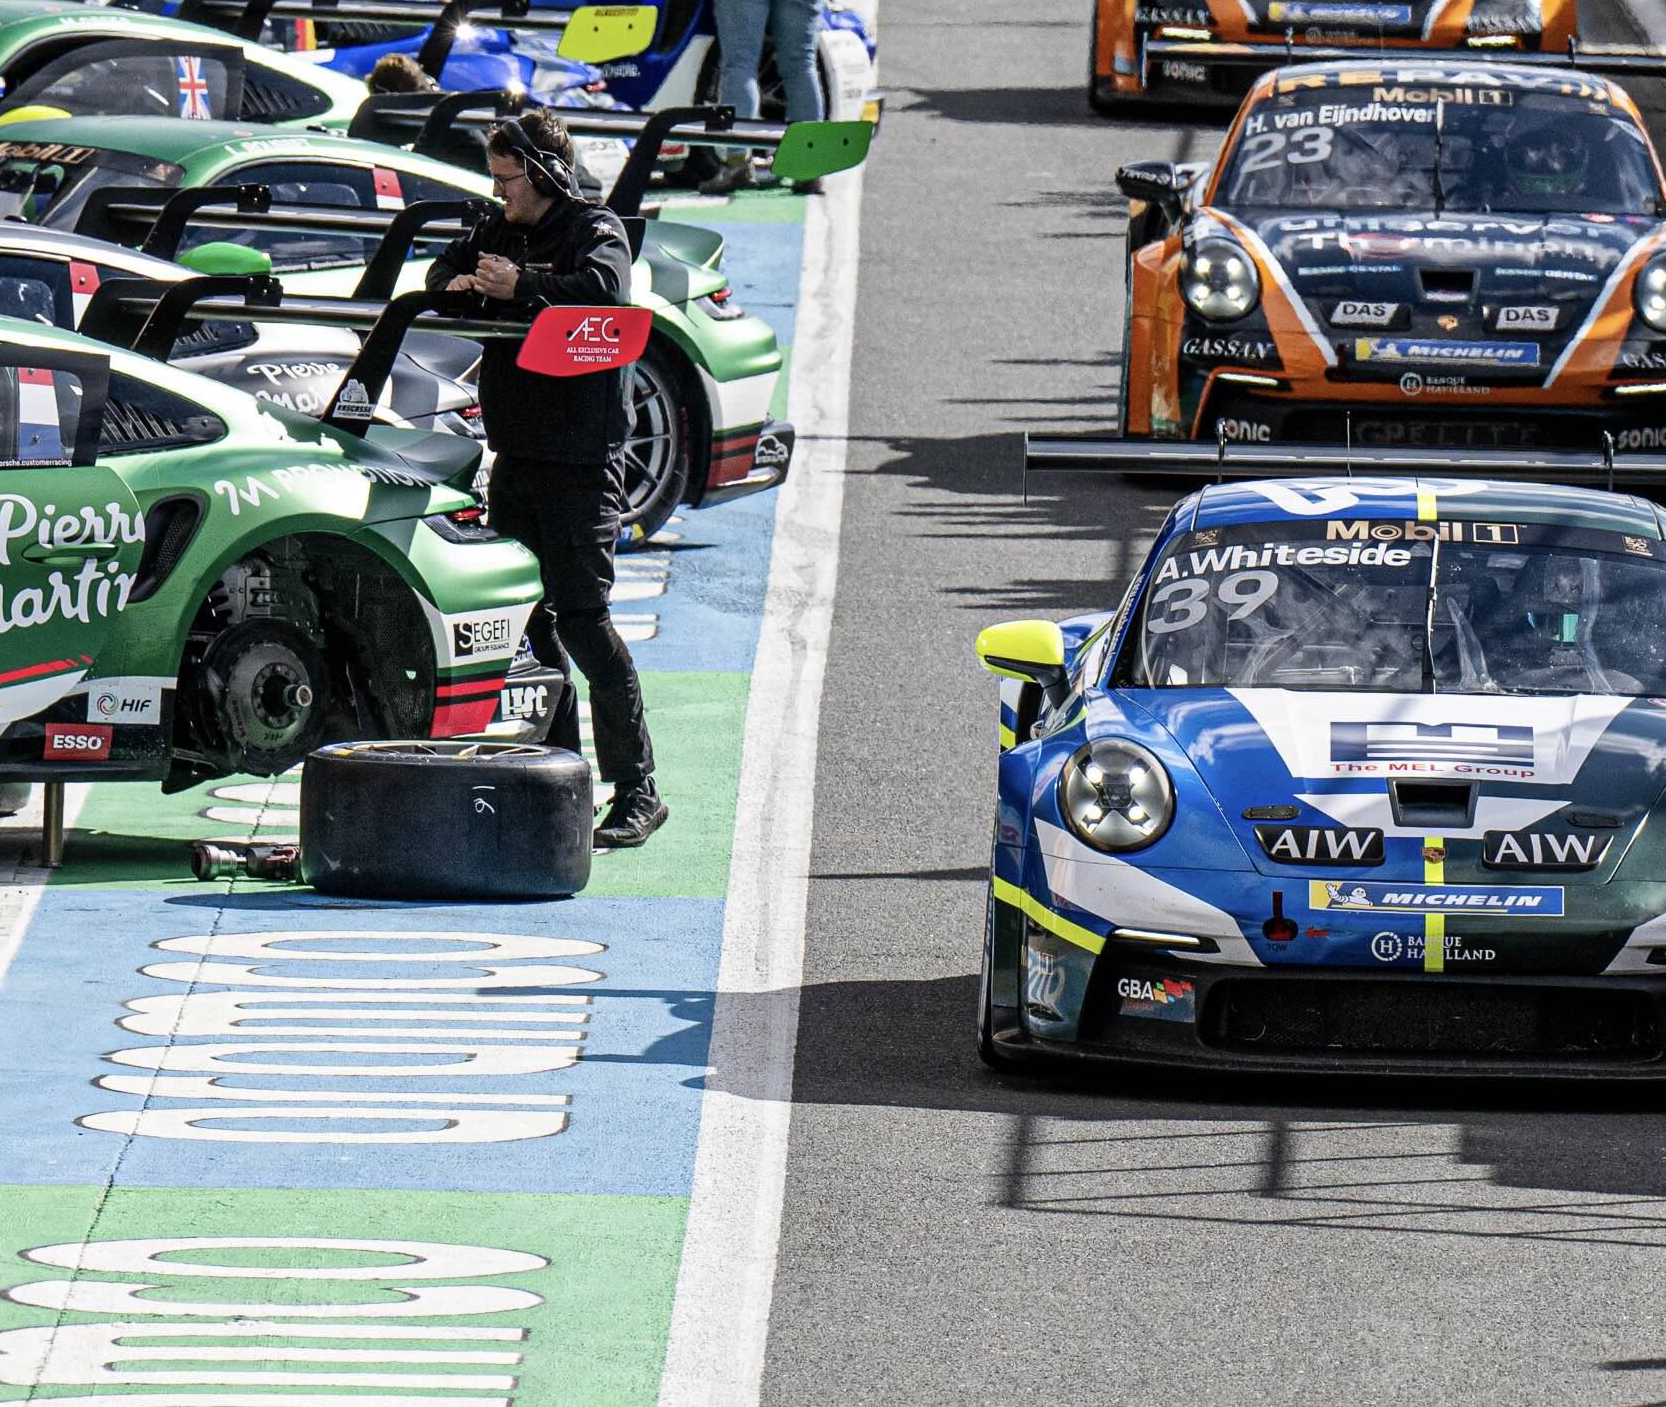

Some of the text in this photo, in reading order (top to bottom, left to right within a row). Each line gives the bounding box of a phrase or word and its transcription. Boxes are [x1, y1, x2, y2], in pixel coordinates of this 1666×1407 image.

[1373, 86, 1474, 105] Mobil
[1244, 116, 1267, 137] H.
[1273, 110, 1314, 128] van
[1240, 125, 1334, 173] 23
[1341, 304, 1386, 317] DAS
[1505, 309, 1550, 322] DAS
[567, 316, 621, 343] AEC
[596, 355, 612, 363] TEAM
[1182, 337, 1271, 361] GASSAN
[1407, 344, 1525, 359] MICHELIN
[247, 361, 341, 386] Pierre
[1325, 520, 1463, 543] Mobil
[1146, 568, 1280, 635] 39
[120, 698, 153, 713] HIF
[52, 734, 103, 751] ESSO
[1333, 762, 1537, 779] The MEL Group
[1270, 829, 1378, 860] AIW
[1493, 833, 1597, 864] AIW
[1381, 892, 1544, 908] MICHELIN
[1117, 977, 1154, 1001] GBA
